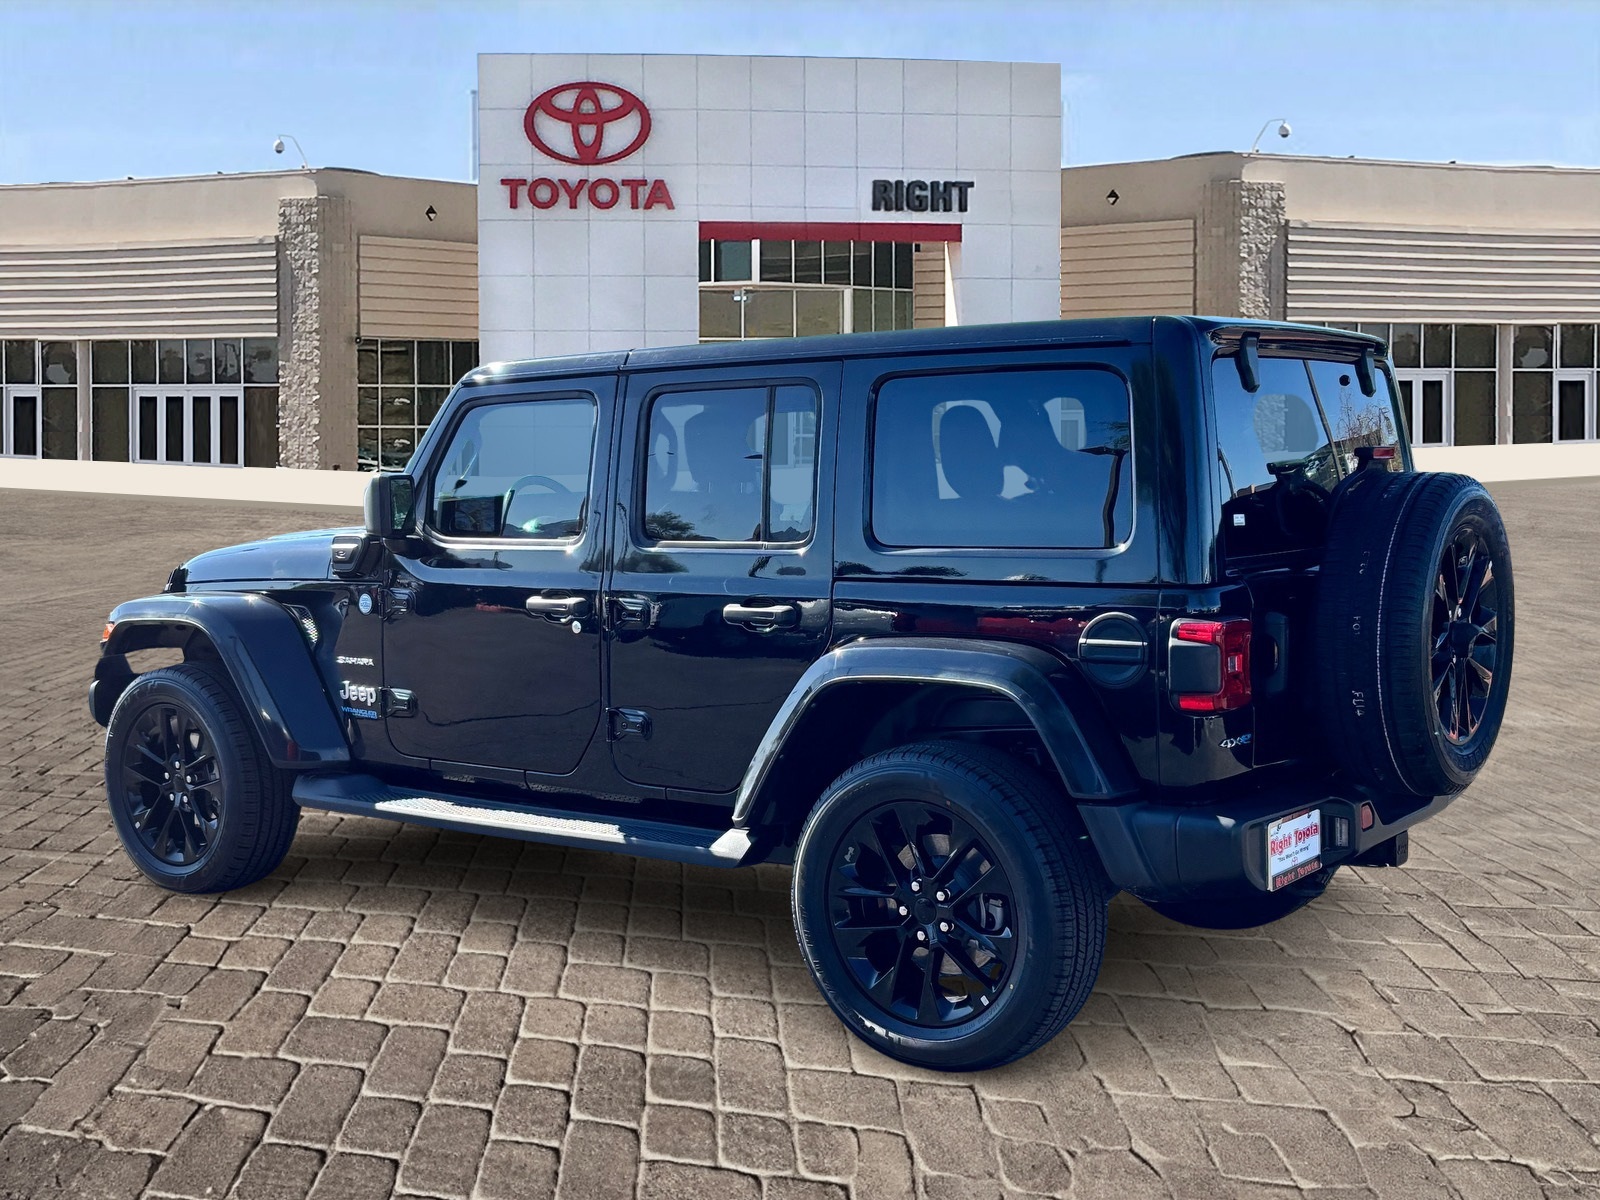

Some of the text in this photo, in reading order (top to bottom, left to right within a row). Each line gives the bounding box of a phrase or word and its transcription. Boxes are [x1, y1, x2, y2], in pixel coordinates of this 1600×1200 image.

[500, 177, 675, 210] TOYOTA
[871, 179, 975, 213] RIGHT
[336, 656, 375, 666] SAHARA
[340, 680, 377, 706] Jeep
[1270, 823, 1319, 856] Right Toyota
